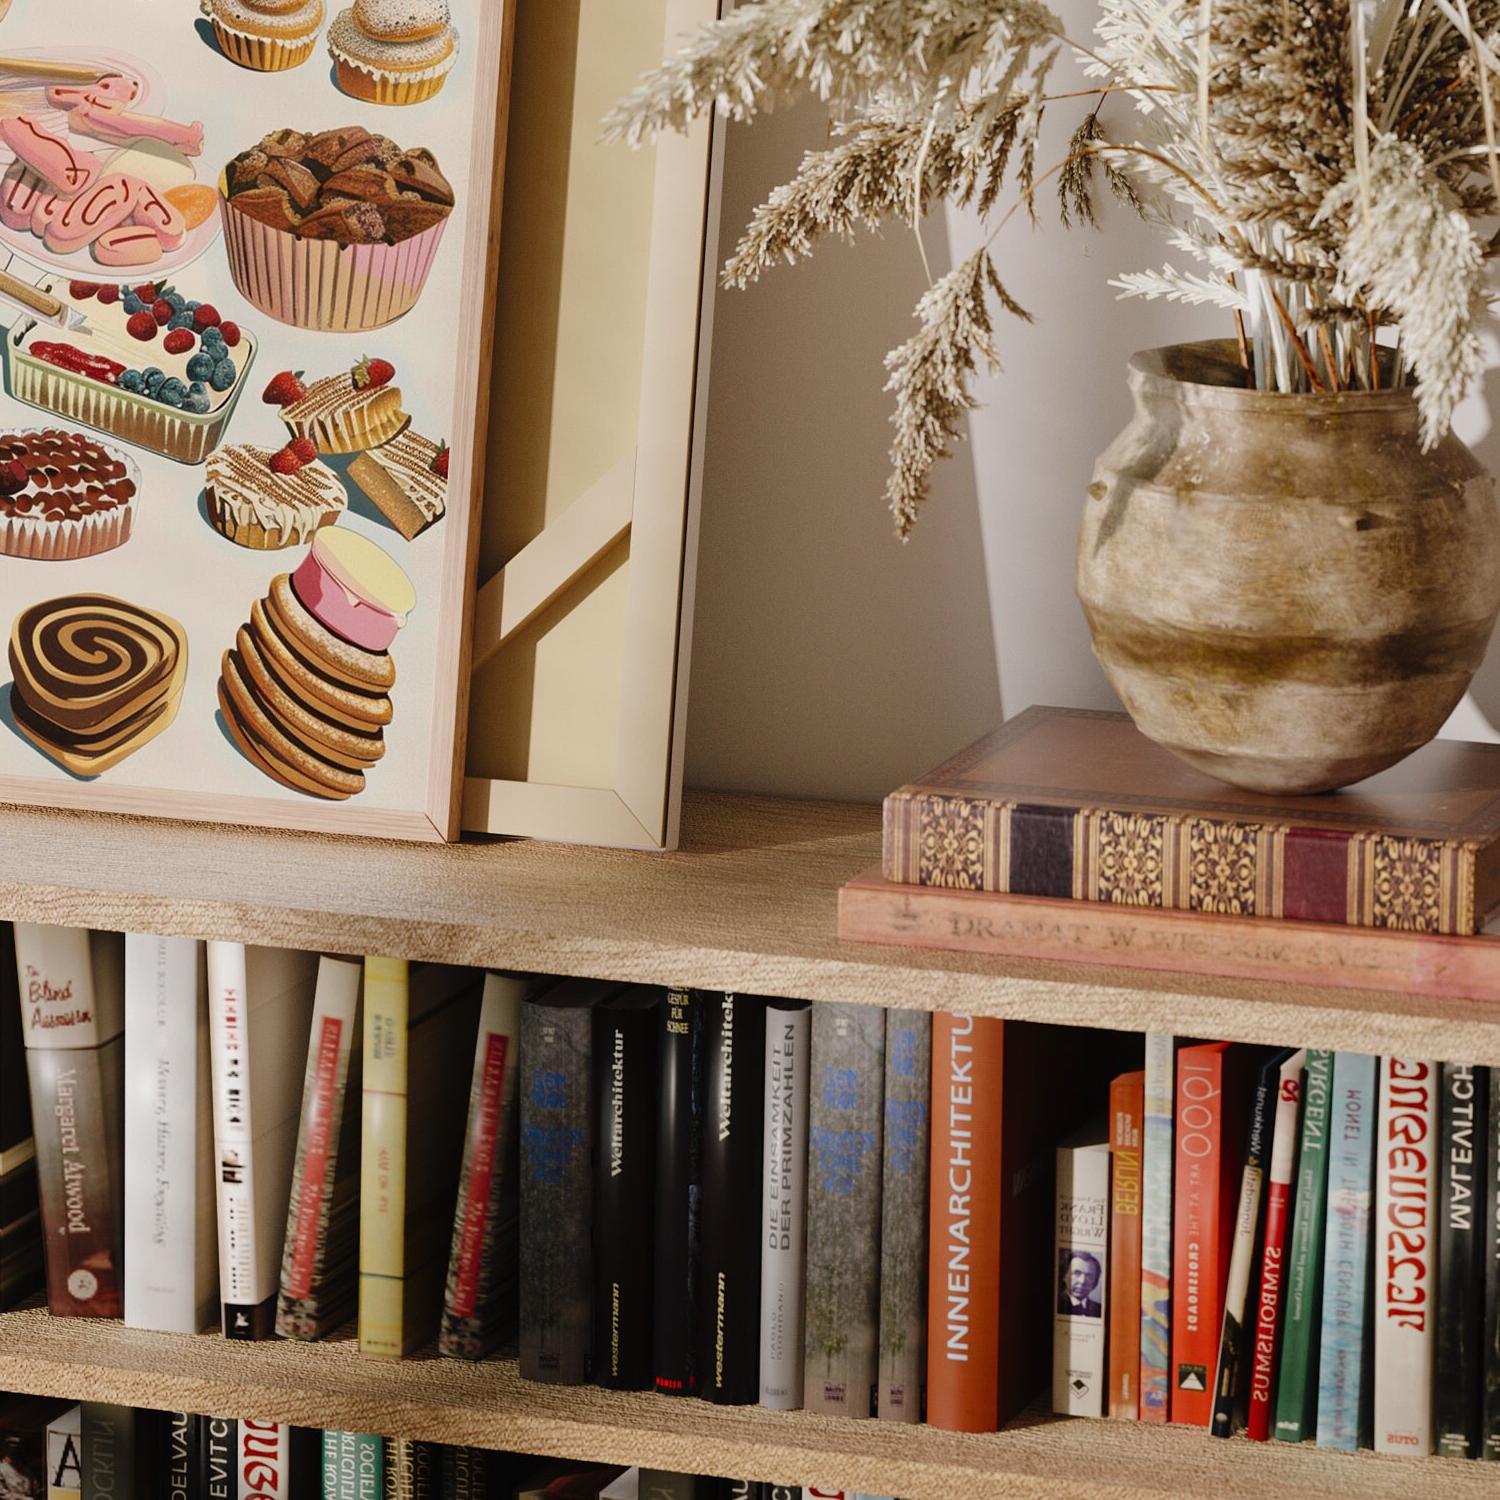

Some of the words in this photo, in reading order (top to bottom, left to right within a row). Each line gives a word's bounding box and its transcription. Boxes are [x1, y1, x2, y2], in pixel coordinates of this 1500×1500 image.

[949, 910, 1092, 944] DRAMAT
[1105, 925, 1138, 950] W
[28, 979, 74, 1005] Blind
[667, 992, 690, 1007] GESPÜR
[670, 1008, 684, 1020] FÜR
[665, 1021, 690, 1036] SCHNEE
[54, 1067, 79, 1155] Margaret
[610, 1028, 625, 1178] Weltarchitektur
[768, 1043, 781, 1201] EINSAMKEIT
[780, 1023, 795, 1192] PRIMZAHLEN
[63, 1159, 92, 1234] Atwood
[780, 1199, 795, 1251] DER
[768, 1208, 781, 1251] DIE
[610, 1282, 620, 1378] westermann
[714, 1271, 726, 1389] westermann
[776, 1282, 785, 1362] GIORDANO
[655, 1375, 683, 1390] HANSER
